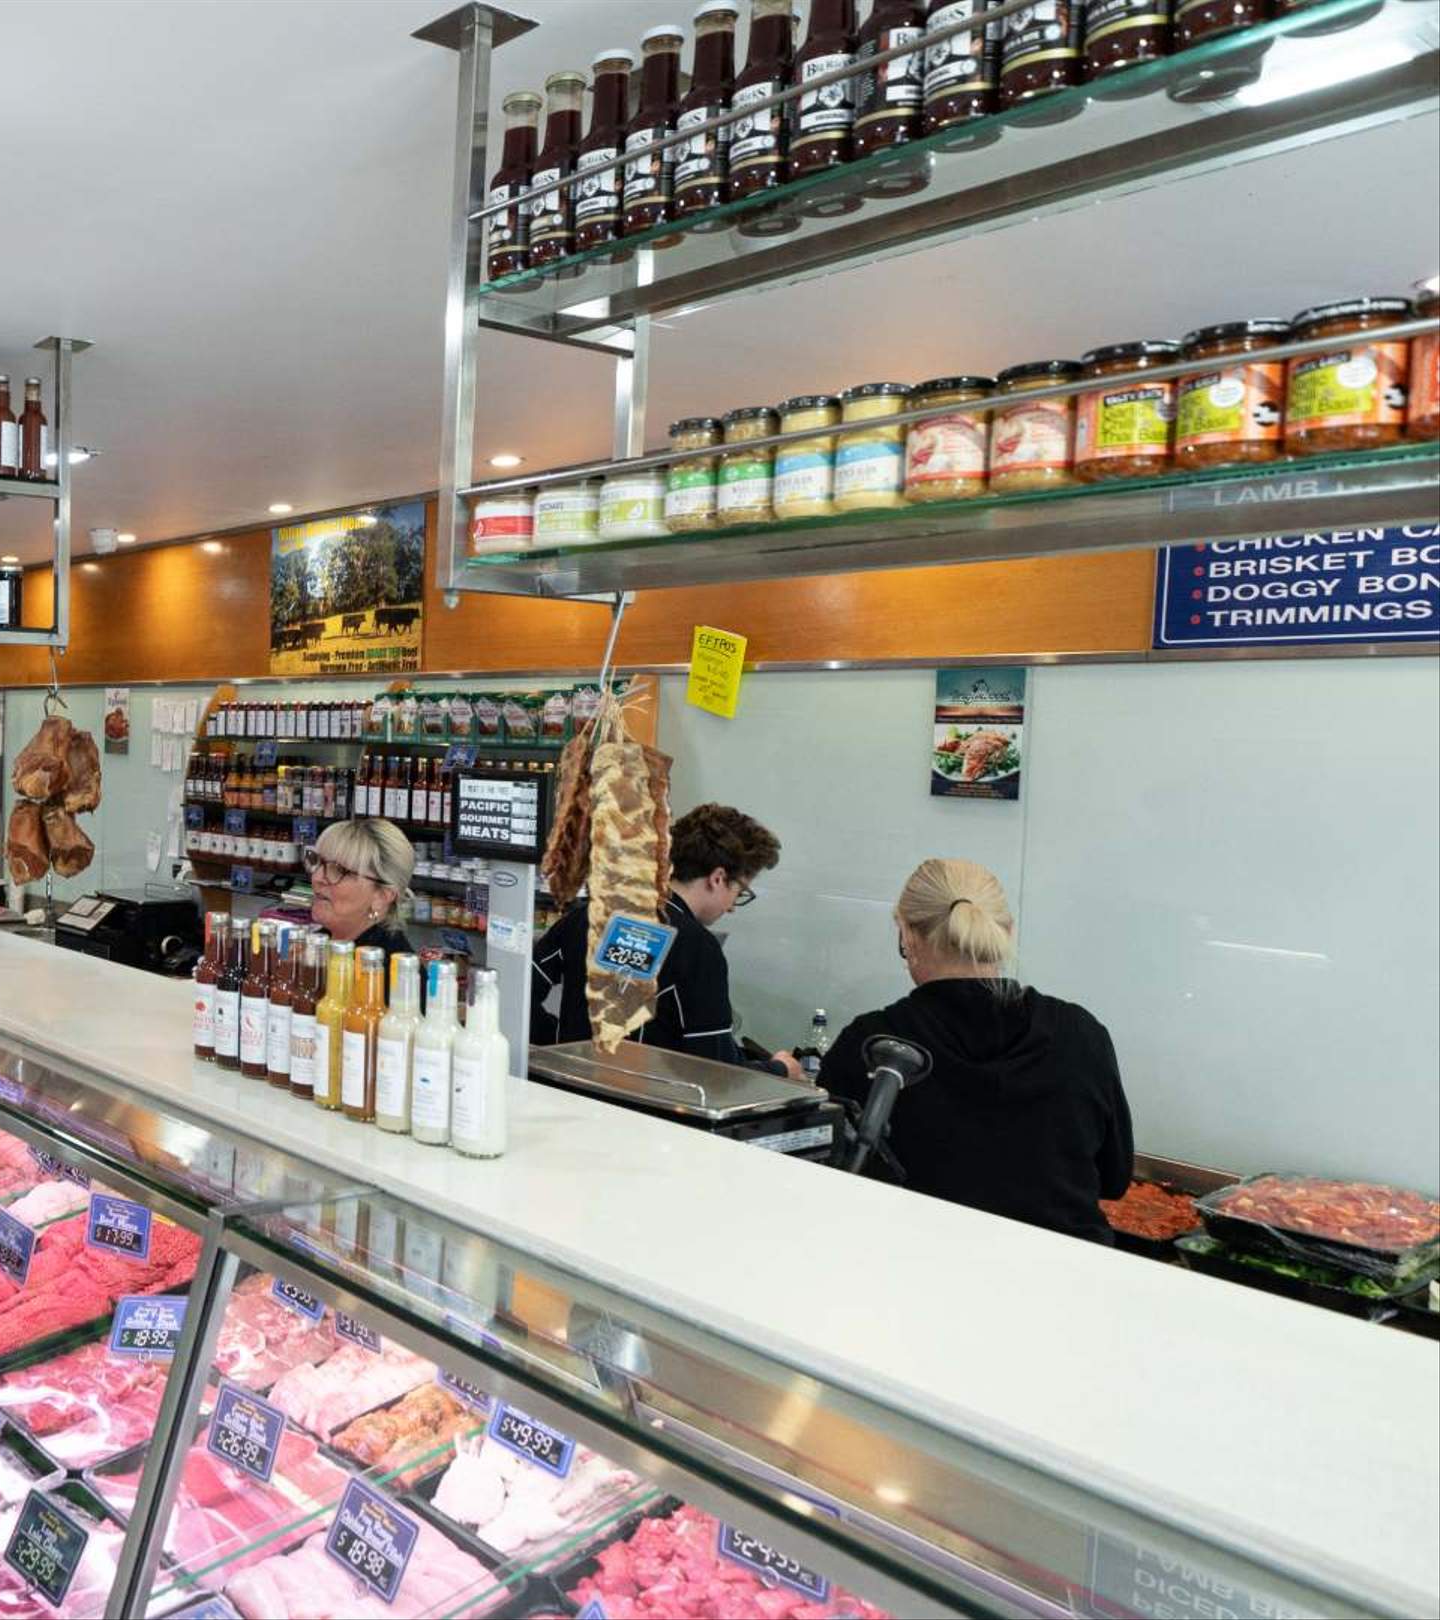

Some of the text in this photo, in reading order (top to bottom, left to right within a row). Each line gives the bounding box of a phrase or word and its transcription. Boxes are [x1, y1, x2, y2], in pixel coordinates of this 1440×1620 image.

[1211, 527, 1384, 555] CHICKEN
[1208, 549, 1375, 579] BRISKET
[1206, 577, 1342, 603] DOGGY
[1206, 599, 1434, 628] TRIMMINGS
[698, 634, 737, 653] EFTPOS
[461, 799, 510, 813] PACIFIC
[460, 813, 510, 826] GOURMET
[461, 825, 510, 841] MEATS
[501, 1417, 554, 1456] $49.99
